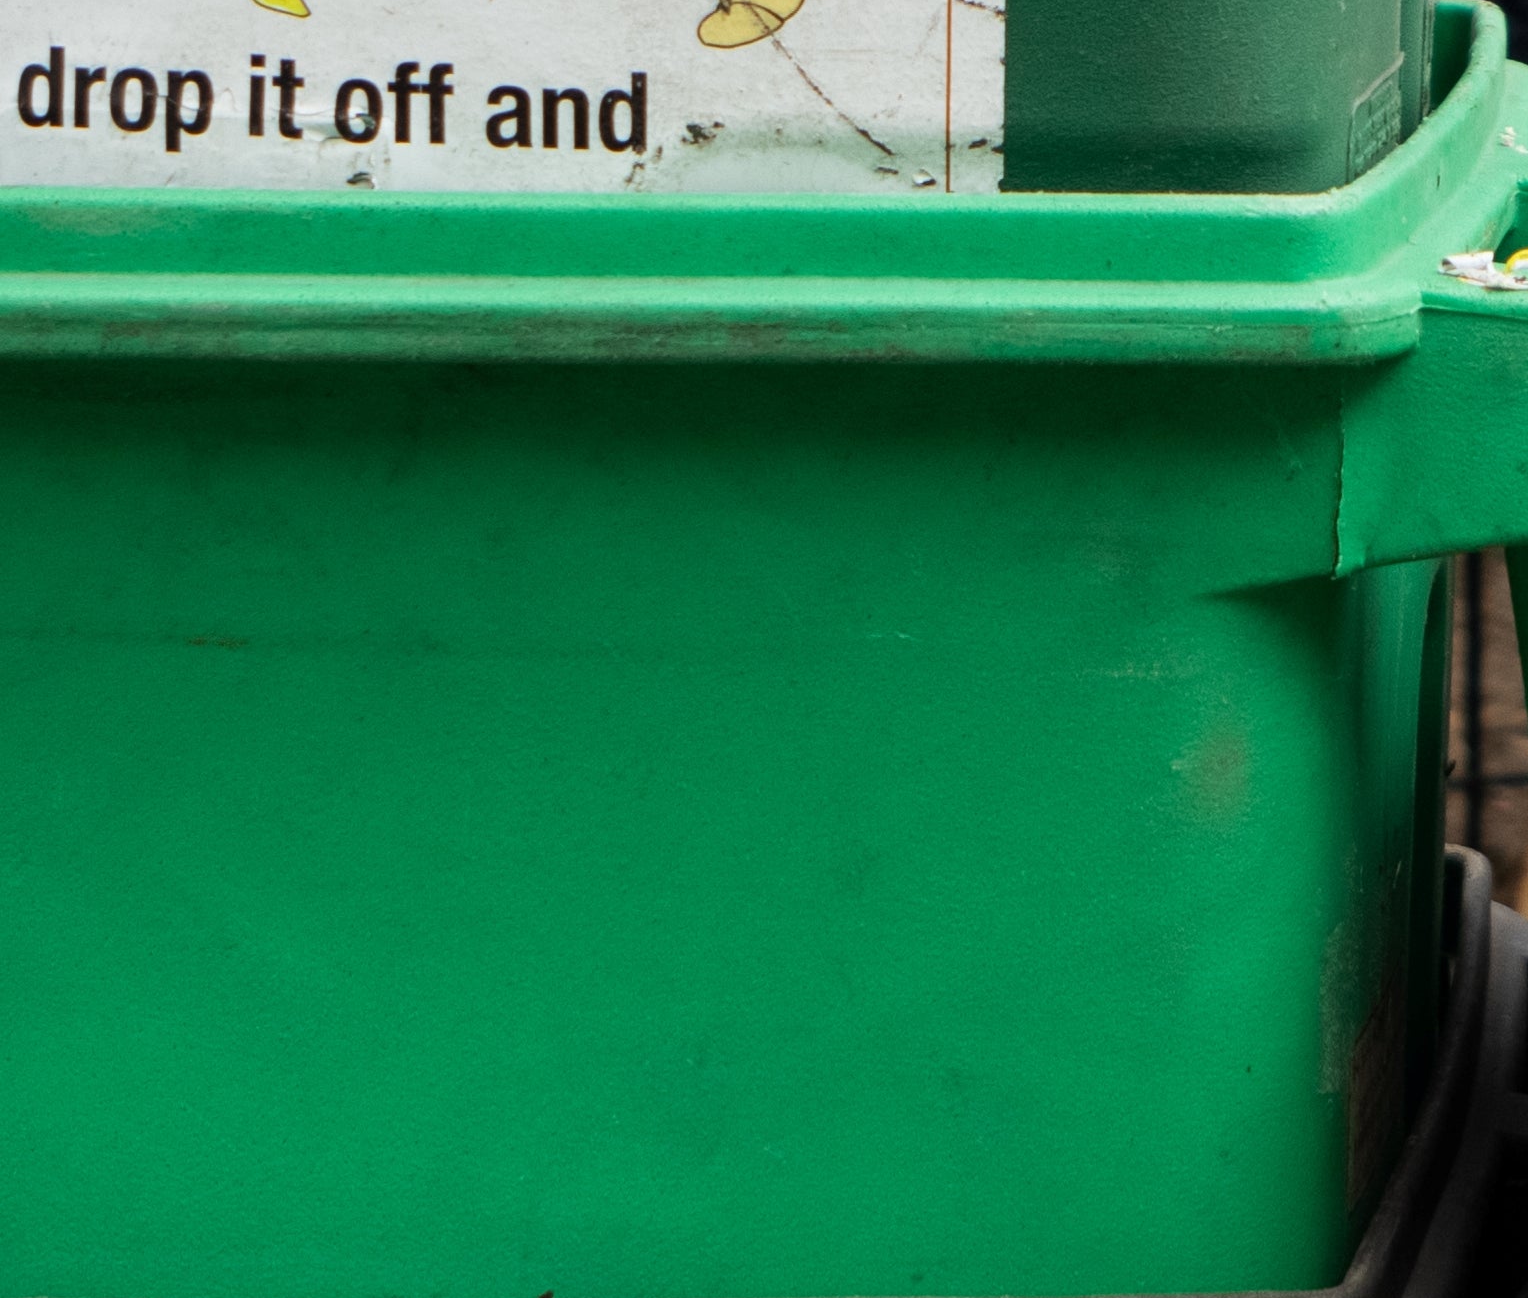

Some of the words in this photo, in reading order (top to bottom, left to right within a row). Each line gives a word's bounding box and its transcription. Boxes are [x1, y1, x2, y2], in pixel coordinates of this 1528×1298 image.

[18, 45, 214, 154] drop
[248, 53, 305, 140] it
[334, 61, 454, 144] off
[485, 71, 648, 153] and
